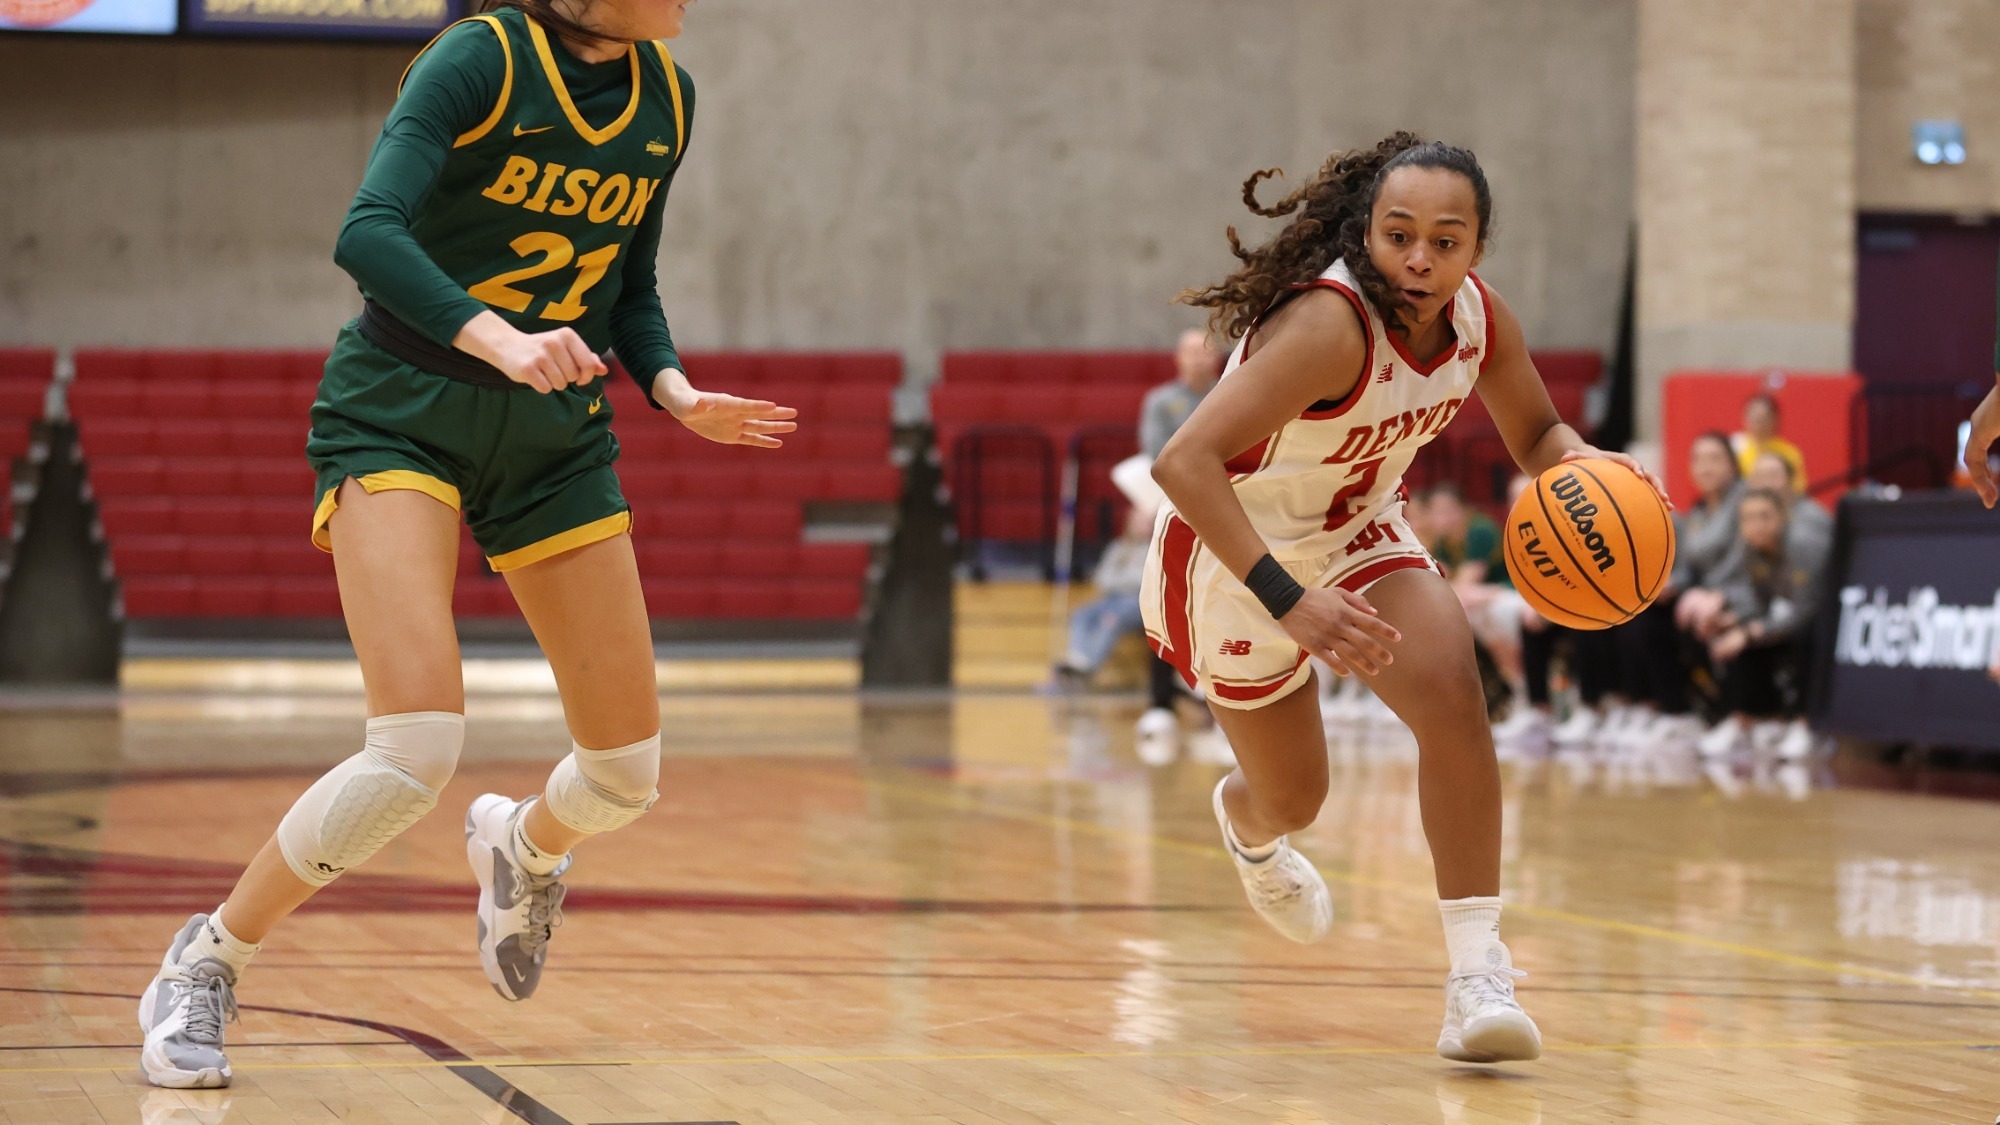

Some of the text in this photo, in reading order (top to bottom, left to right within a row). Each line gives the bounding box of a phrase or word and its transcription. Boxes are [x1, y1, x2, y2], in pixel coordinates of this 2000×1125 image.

[481, 155, 661, 226] BISON
[467, 231, 621, 321] 21
[1320, 398, 1464, 465] DENVE
[1322, 456, 1387, 532] 2
[1550, 471, 1616, 573] Wilson
[1518, 521, 1561, 577] EVO
